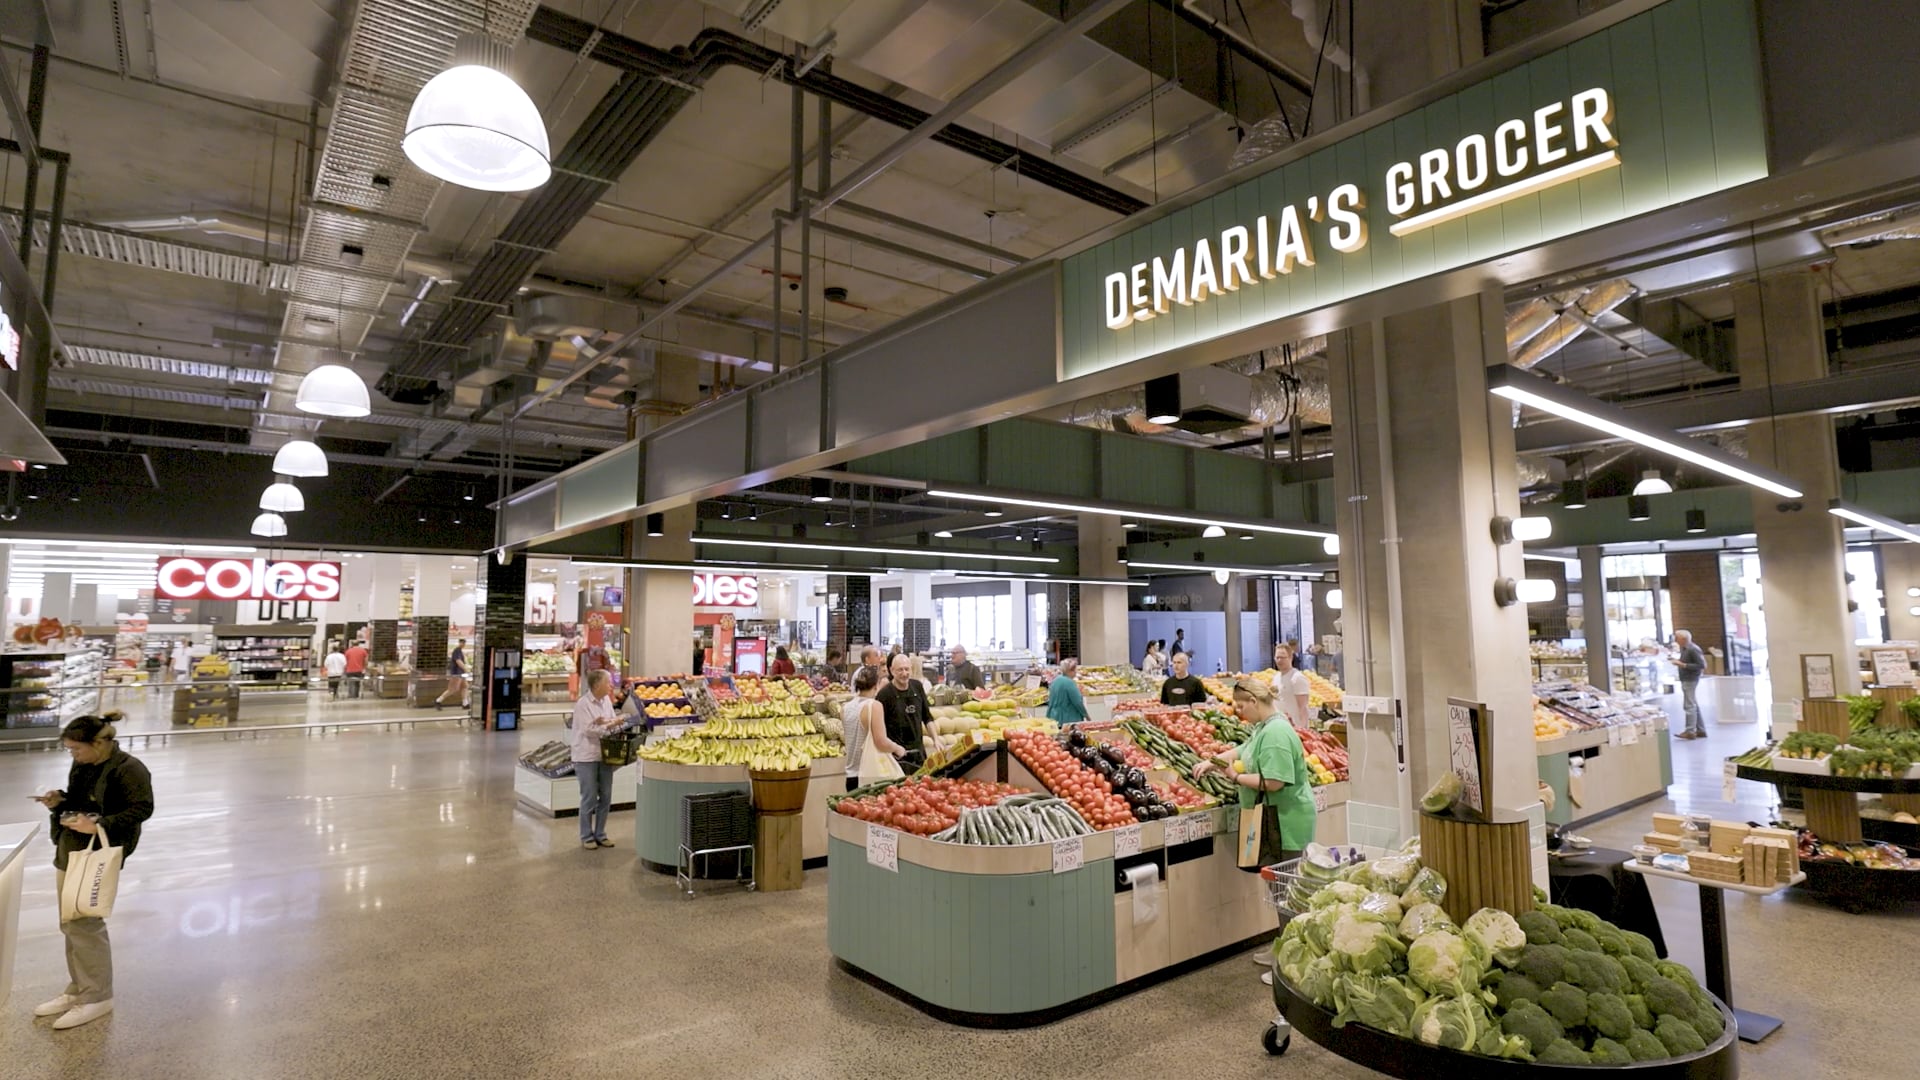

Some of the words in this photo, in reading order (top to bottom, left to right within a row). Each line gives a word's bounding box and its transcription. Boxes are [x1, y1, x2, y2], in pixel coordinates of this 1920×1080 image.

[1385, 86, 1619, 217] GROCER
[157, 557, 340, 599] coles
[692, 572, 759, 606] oles
